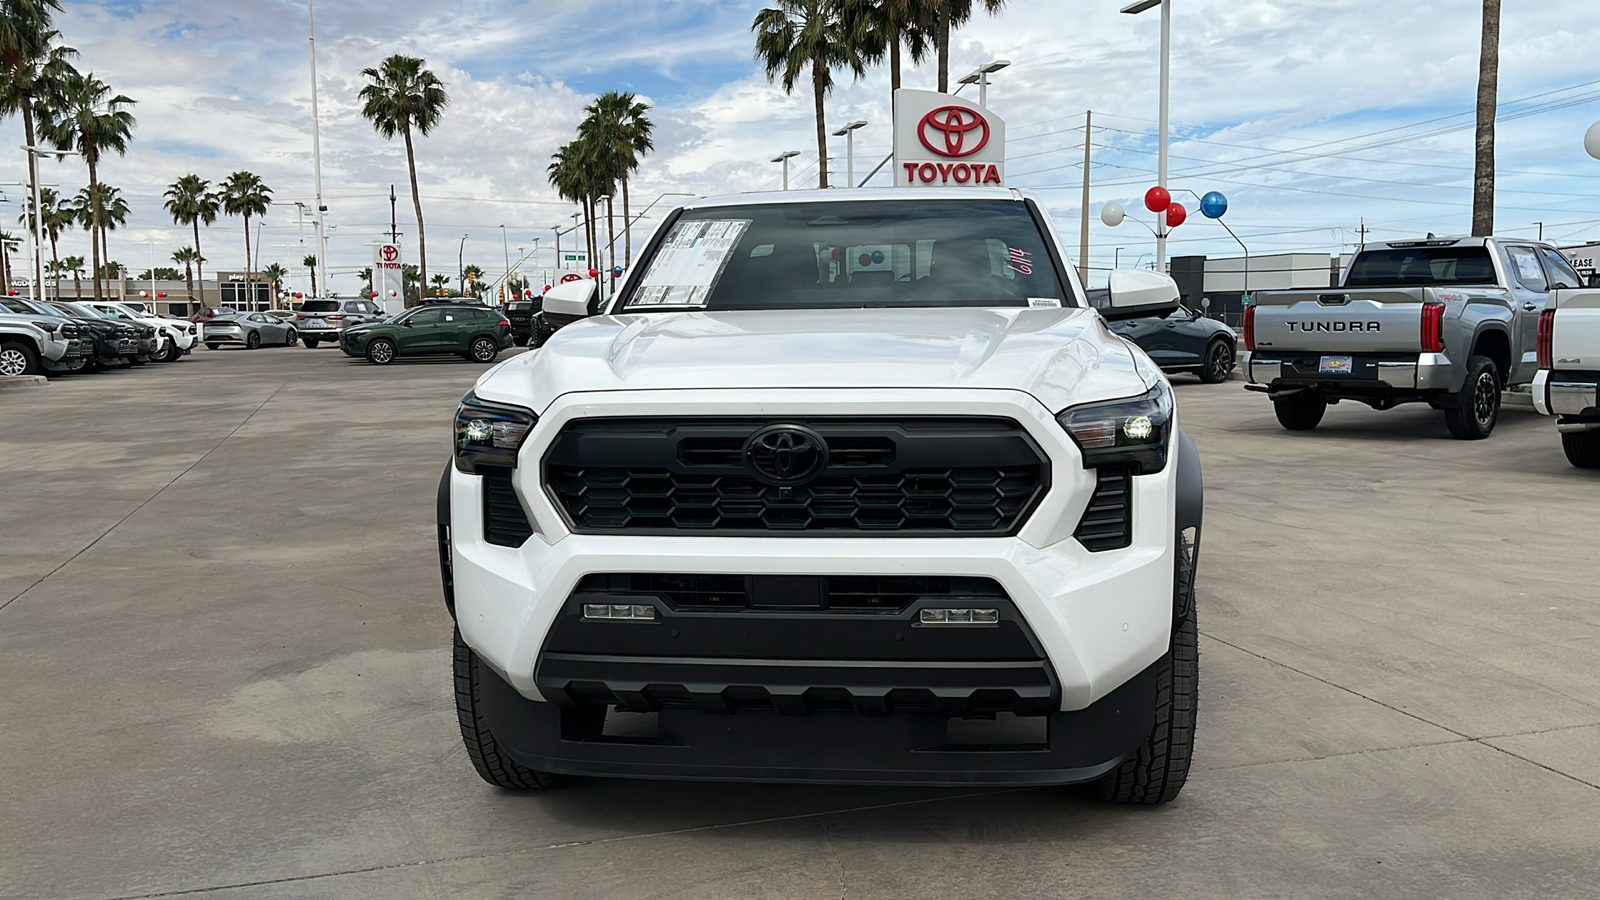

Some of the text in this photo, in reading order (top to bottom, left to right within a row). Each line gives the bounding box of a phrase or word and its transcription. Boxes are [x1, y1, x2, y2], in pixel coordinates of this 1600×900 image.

[903, 162, 1001, 184] TOYOTA
[1007, 247, 1033, 275] 6114
[11, 279, 57, 287] McDonds
[1285, 321, 1381, 333] TUNDRA
